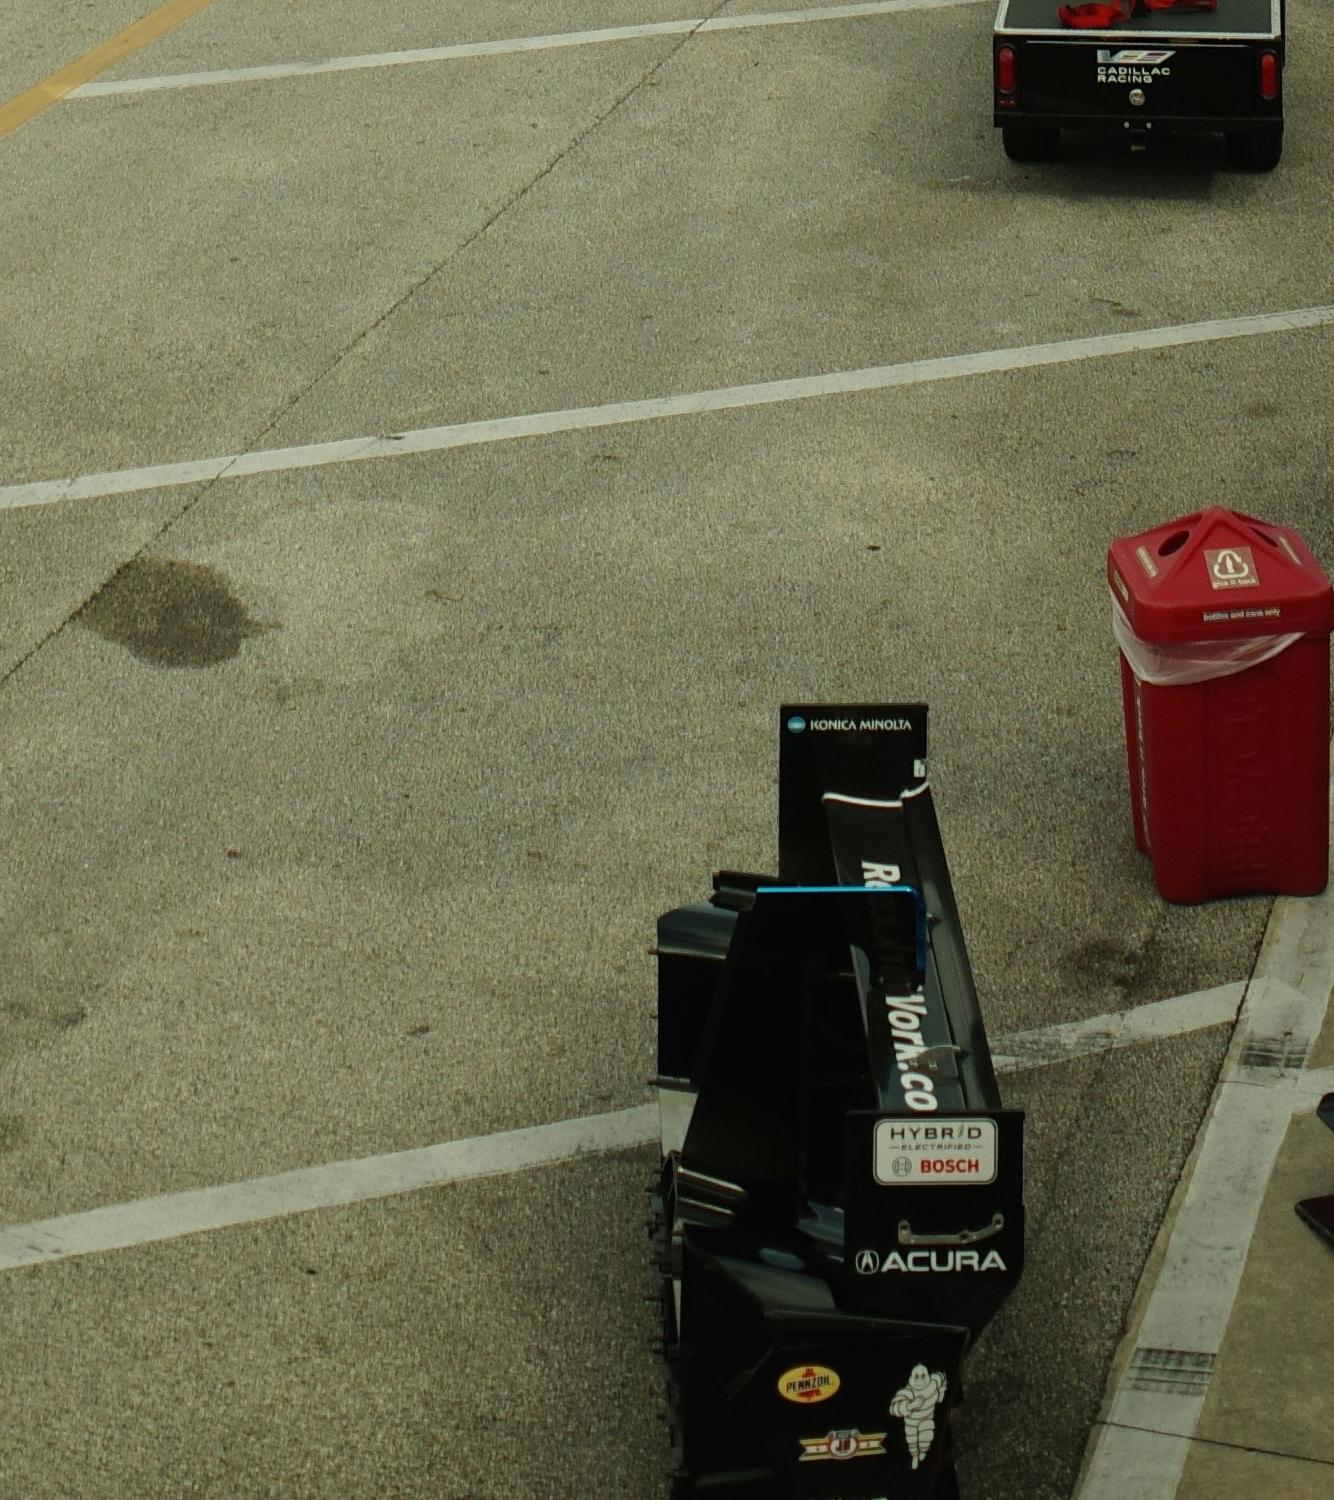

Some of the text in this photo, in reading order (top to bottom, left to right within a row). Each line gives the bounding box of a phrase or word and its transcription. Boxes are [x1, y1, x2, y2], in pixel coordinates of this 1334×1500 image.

[1096, 66, 1171, 76] CADILLAC
[1096, 75, 1153, 84] RACING
[810, 718, 913, 731] KONICA MINOLTA
[890, 1126, 982, 1140] HYBRID
[920, 1159, 979, 1174] BOSCH
[880, 1250, 1008, 1273] ACURA
[785, 1375, 833, 1392] PENNZOIL
